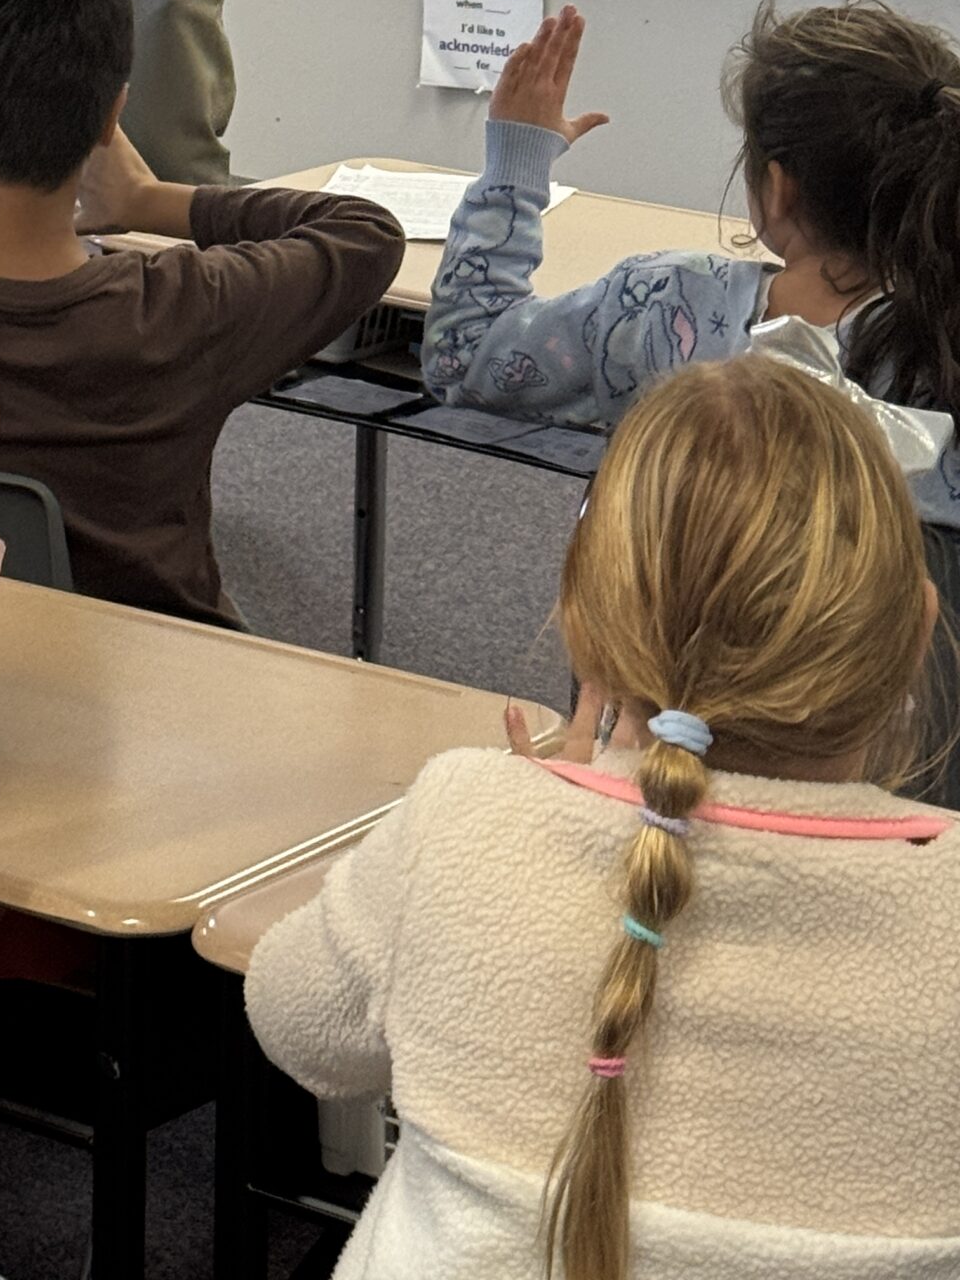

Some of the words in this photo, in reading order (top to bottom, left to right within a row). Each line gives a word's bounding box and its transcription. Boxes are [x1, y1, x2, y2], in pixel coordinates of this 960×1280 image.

[456, 0, 483, 10] when
[461, 23, 474, 34] I'd
[477, 24, 494, 36] like
[496, 26, 505, 38] to
[476, 59, 490, 70] for
